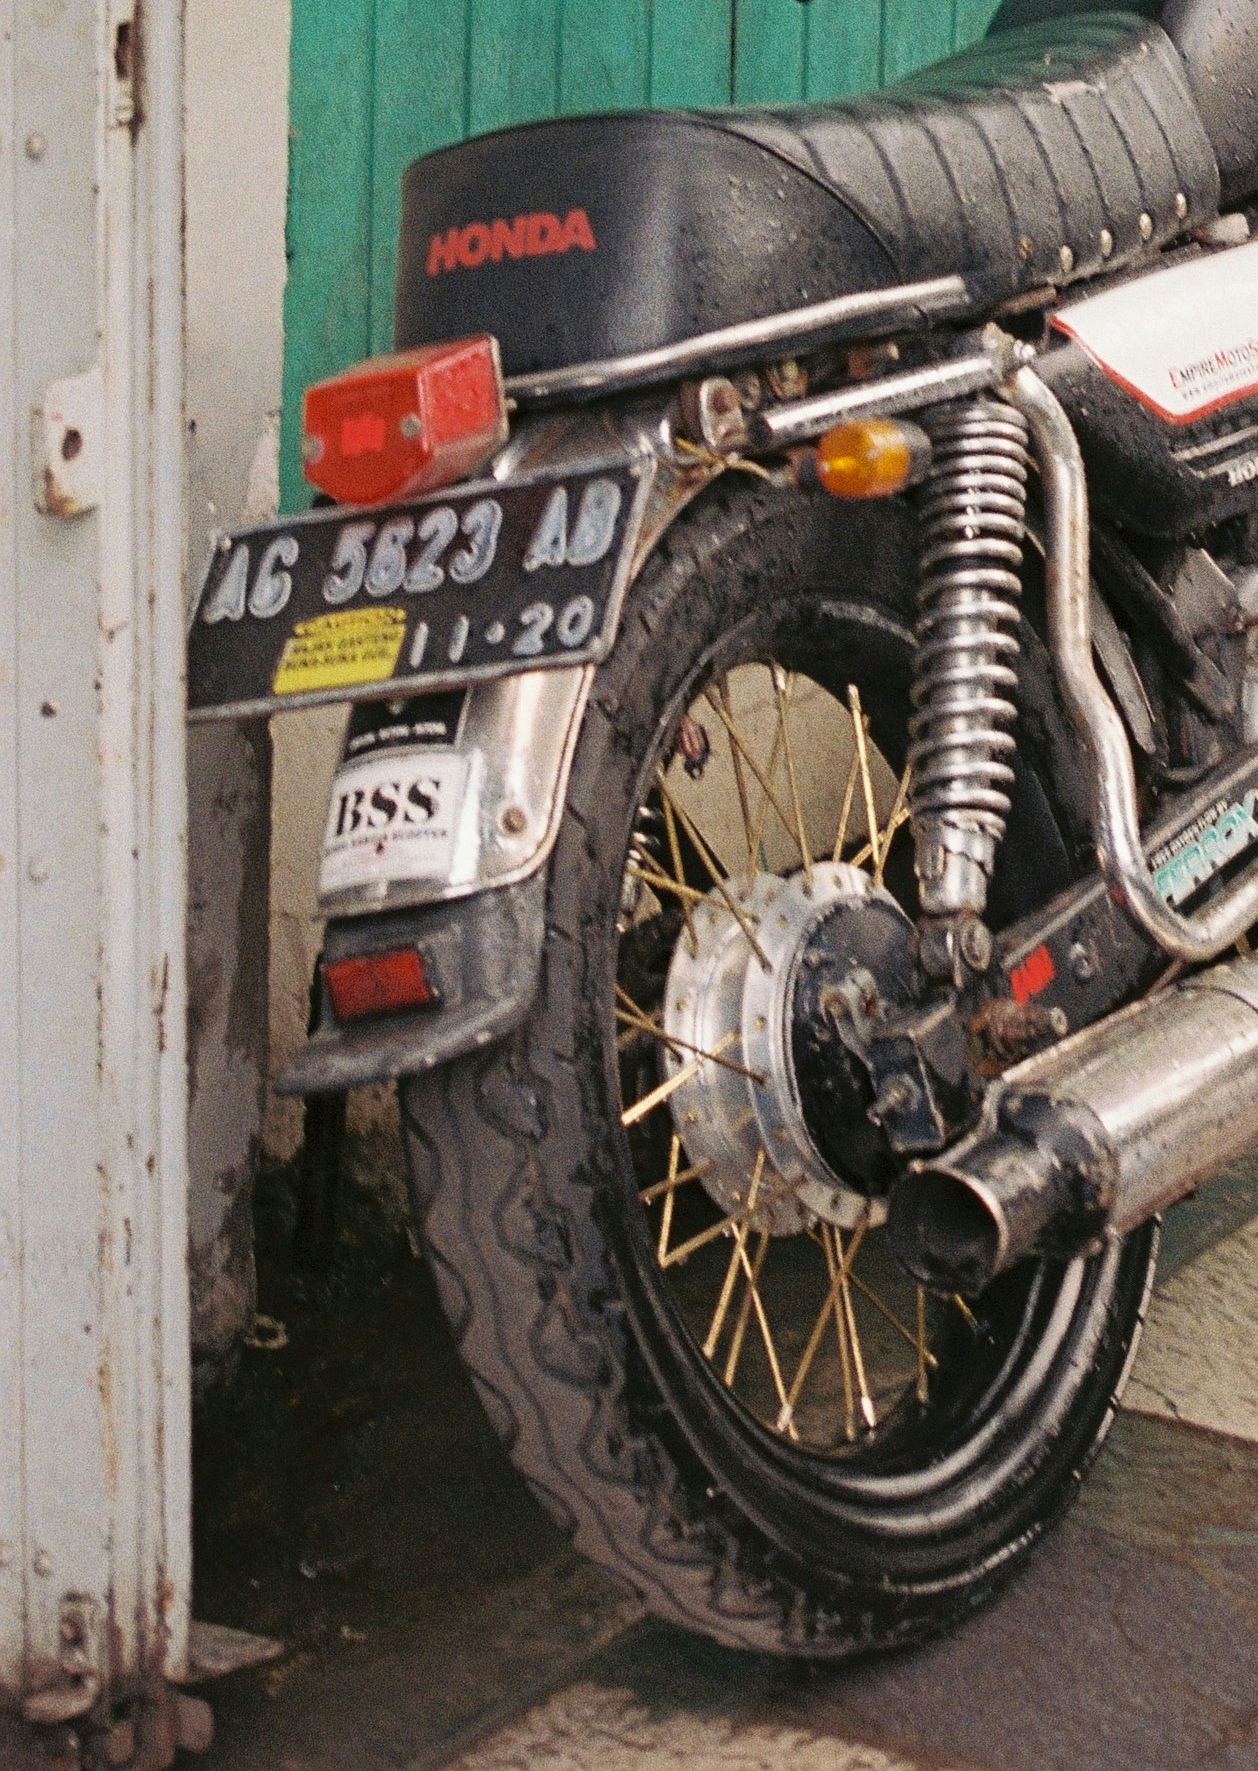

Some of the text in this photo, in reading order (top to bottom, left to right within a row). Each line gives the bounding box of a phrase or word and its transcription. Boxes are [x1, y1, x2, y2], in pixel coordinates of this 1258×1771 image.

[425, 207, 597, 276] HONDA
[202, 535, 299, 625] AG
[336, 777, 441, 836] BSS
